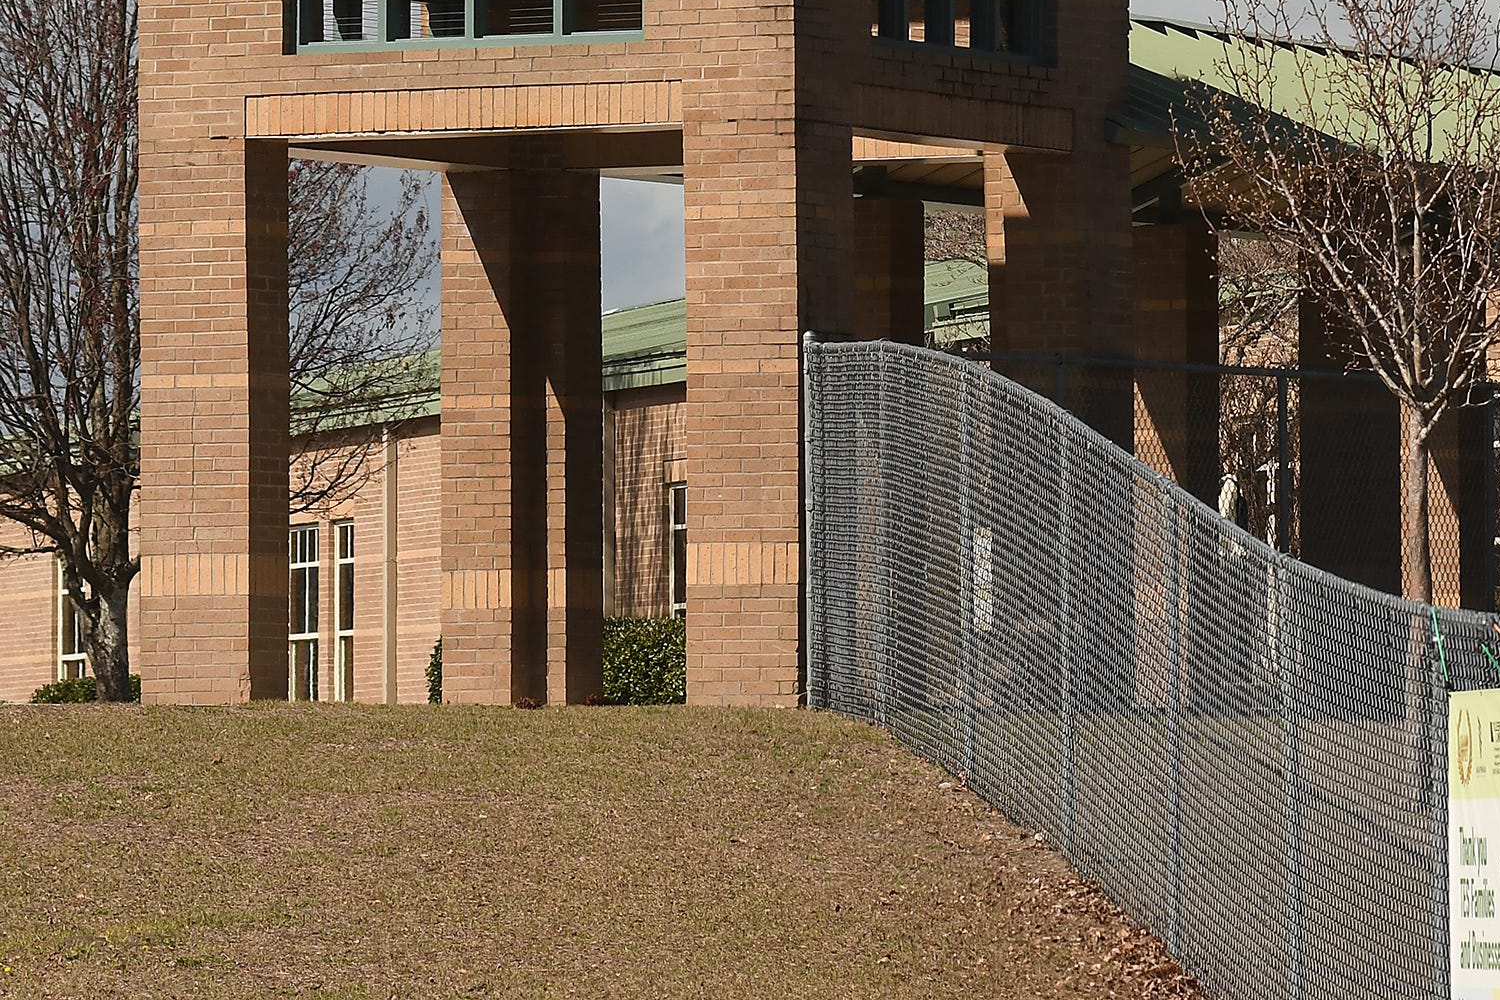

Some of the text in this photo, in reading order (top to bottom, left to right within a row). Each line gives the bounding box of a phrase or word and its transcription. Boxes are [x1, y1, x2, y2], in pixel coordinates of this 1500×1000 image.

[1459, 826, 1488, 876] Thank you
[1471, 878, 1496, 918] Families
[1460, 930, 1471, 970] and
